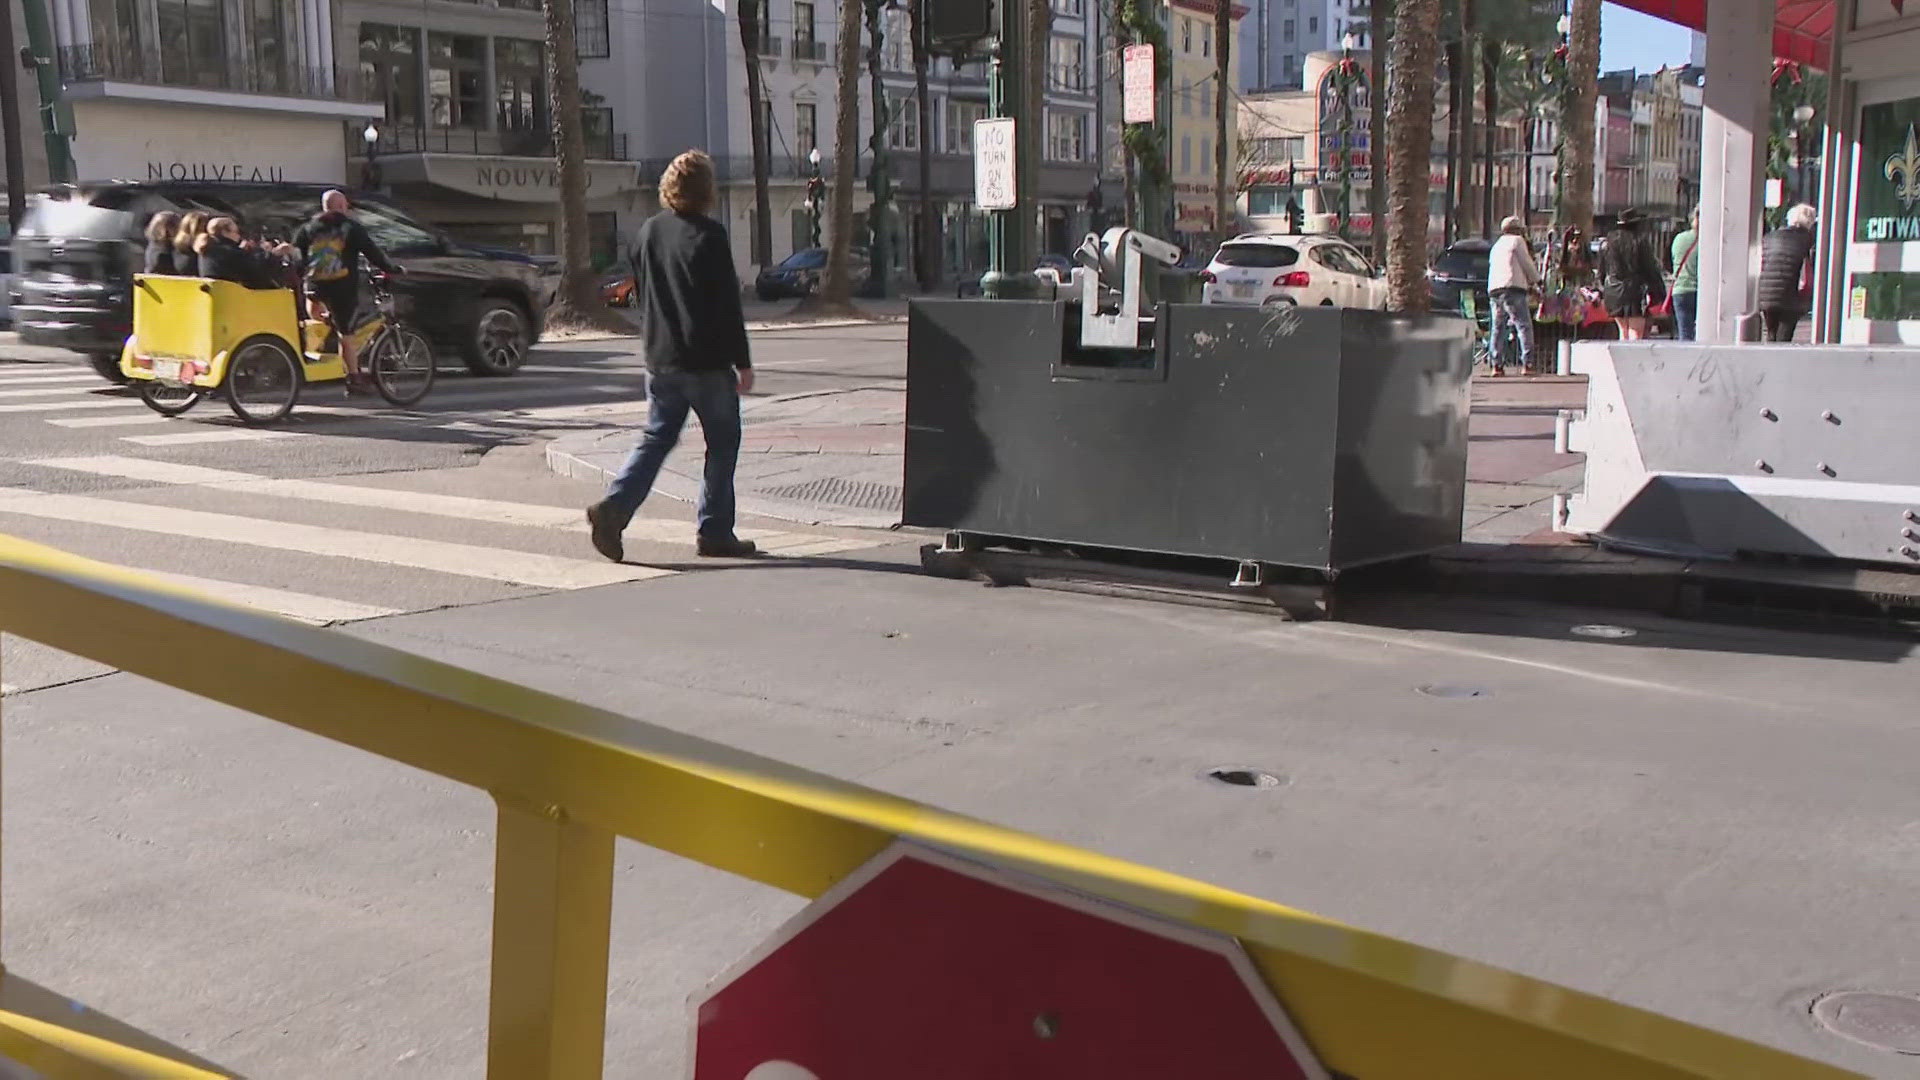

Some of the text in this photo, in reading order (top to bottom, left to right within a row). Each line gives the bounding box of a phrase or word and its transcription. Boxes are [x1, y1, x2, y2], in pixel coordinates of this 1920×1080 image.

[985, 129, 1004, 146] NO
[983, 150, 1006, 165] TURN
[147, 162, 283, 184] NOUVEAU
[988, 169, 1001, 182] ON
[1867, 216, 1920, 239] CUTWA
